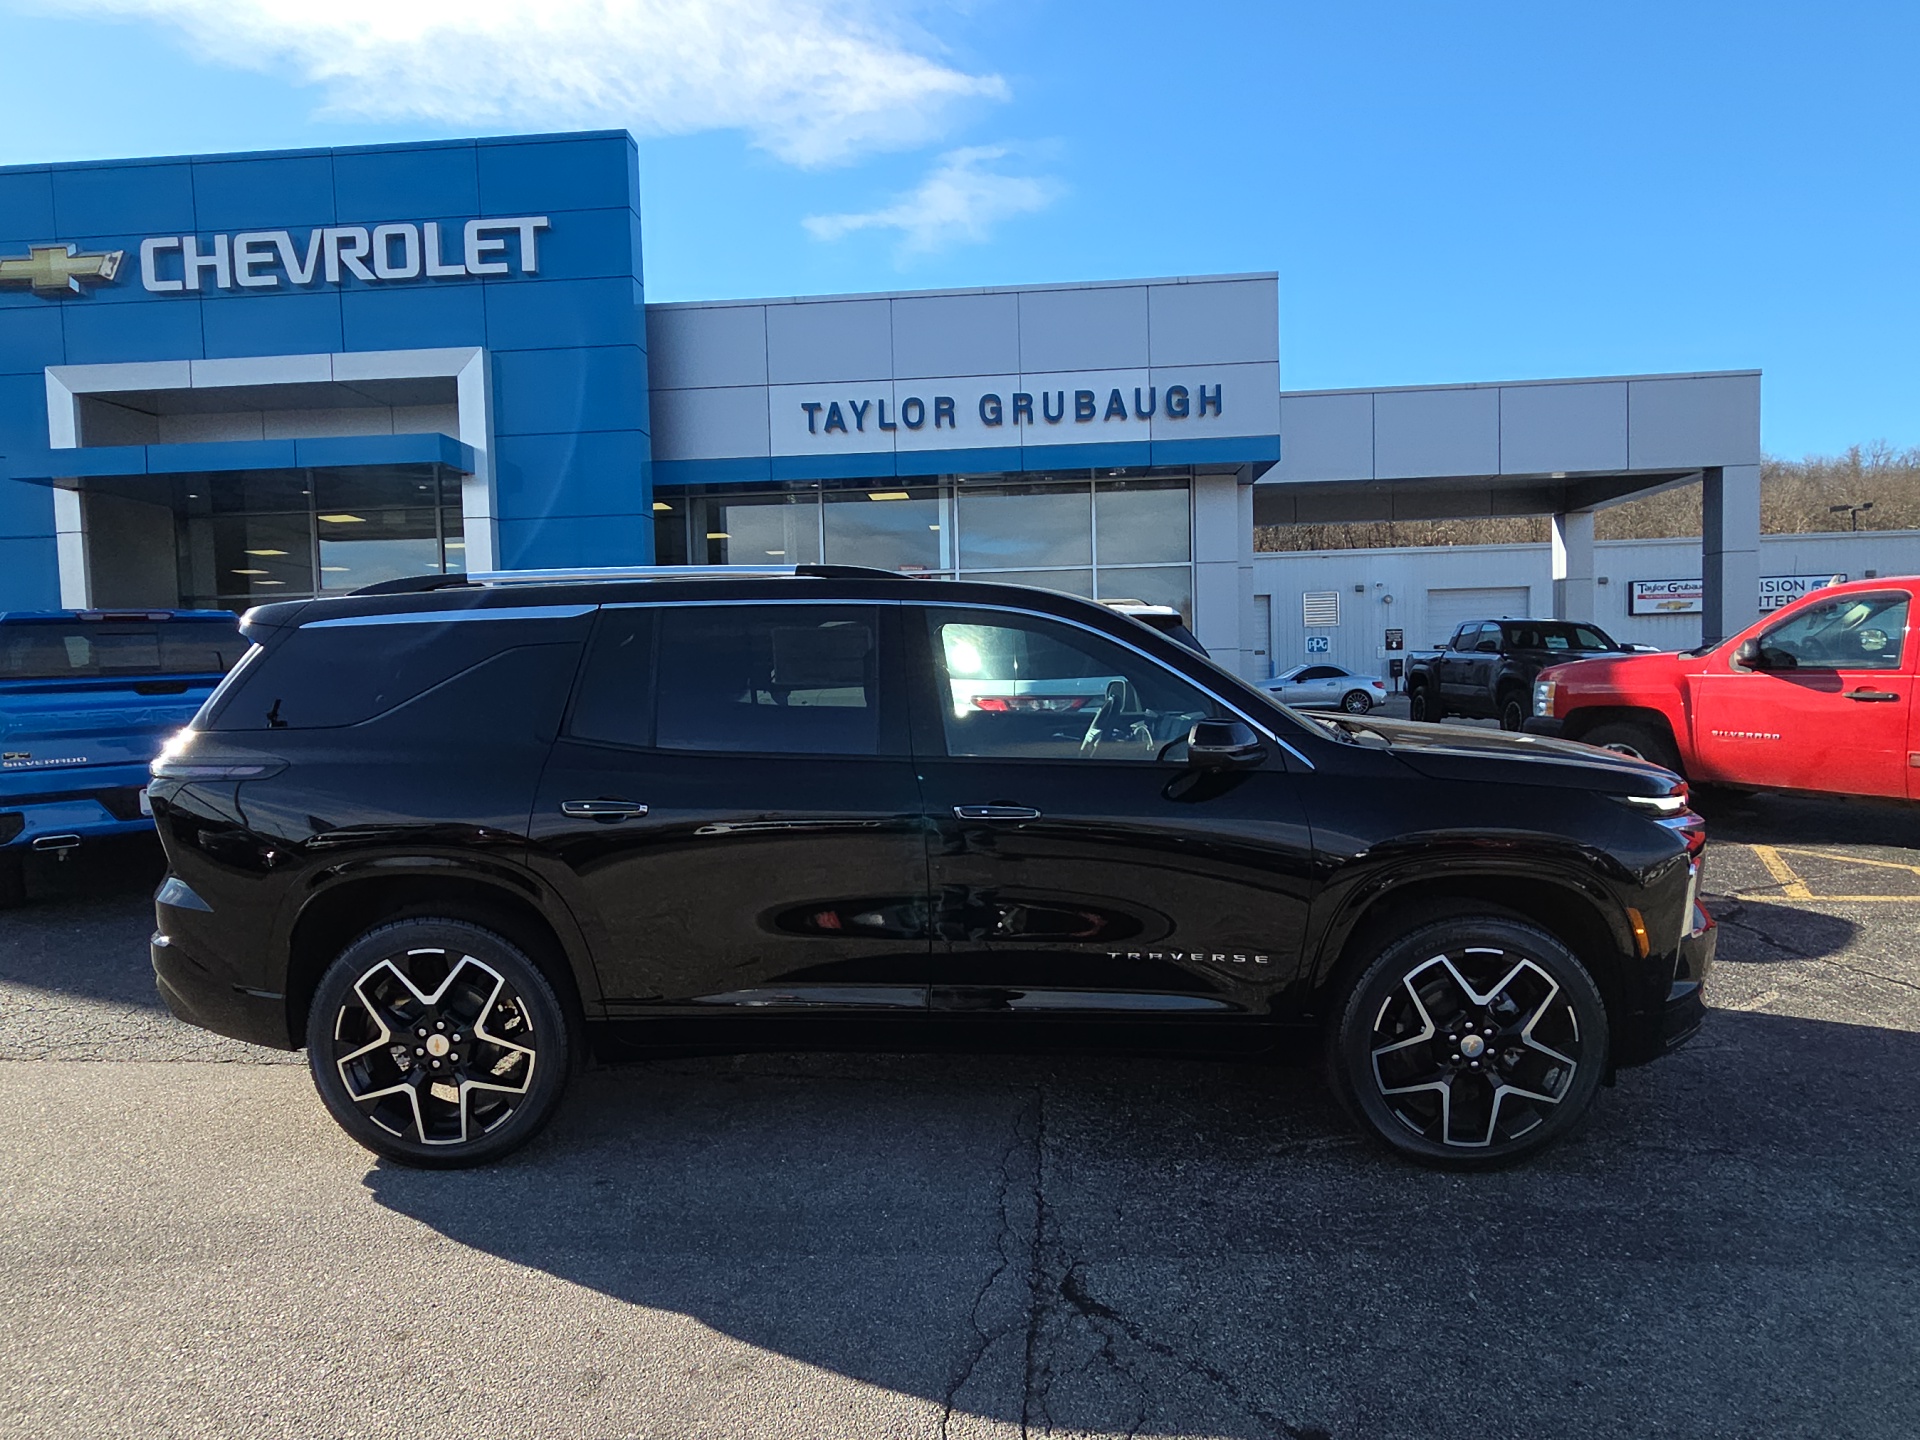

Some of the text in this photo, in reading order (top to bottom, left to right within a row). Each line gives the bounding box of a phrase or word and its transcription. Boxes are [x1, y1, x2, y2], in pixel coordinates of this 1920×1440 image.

[140, 216, 549, 292] CHEVROLET
[801, 384, 1223, 434] TAYLOR GRUBAUGH
[1637, 583, 1666, 594] Taylor
[1760, 580, 1805, 592] ISION
[1308, 638, 1328, 651] PPG
[1711, 729, 1781, 740] SILVERADO
[3, 756, 87, 768] SILVERADO
[1106, 952, 1269, 964] TRAVERSE
